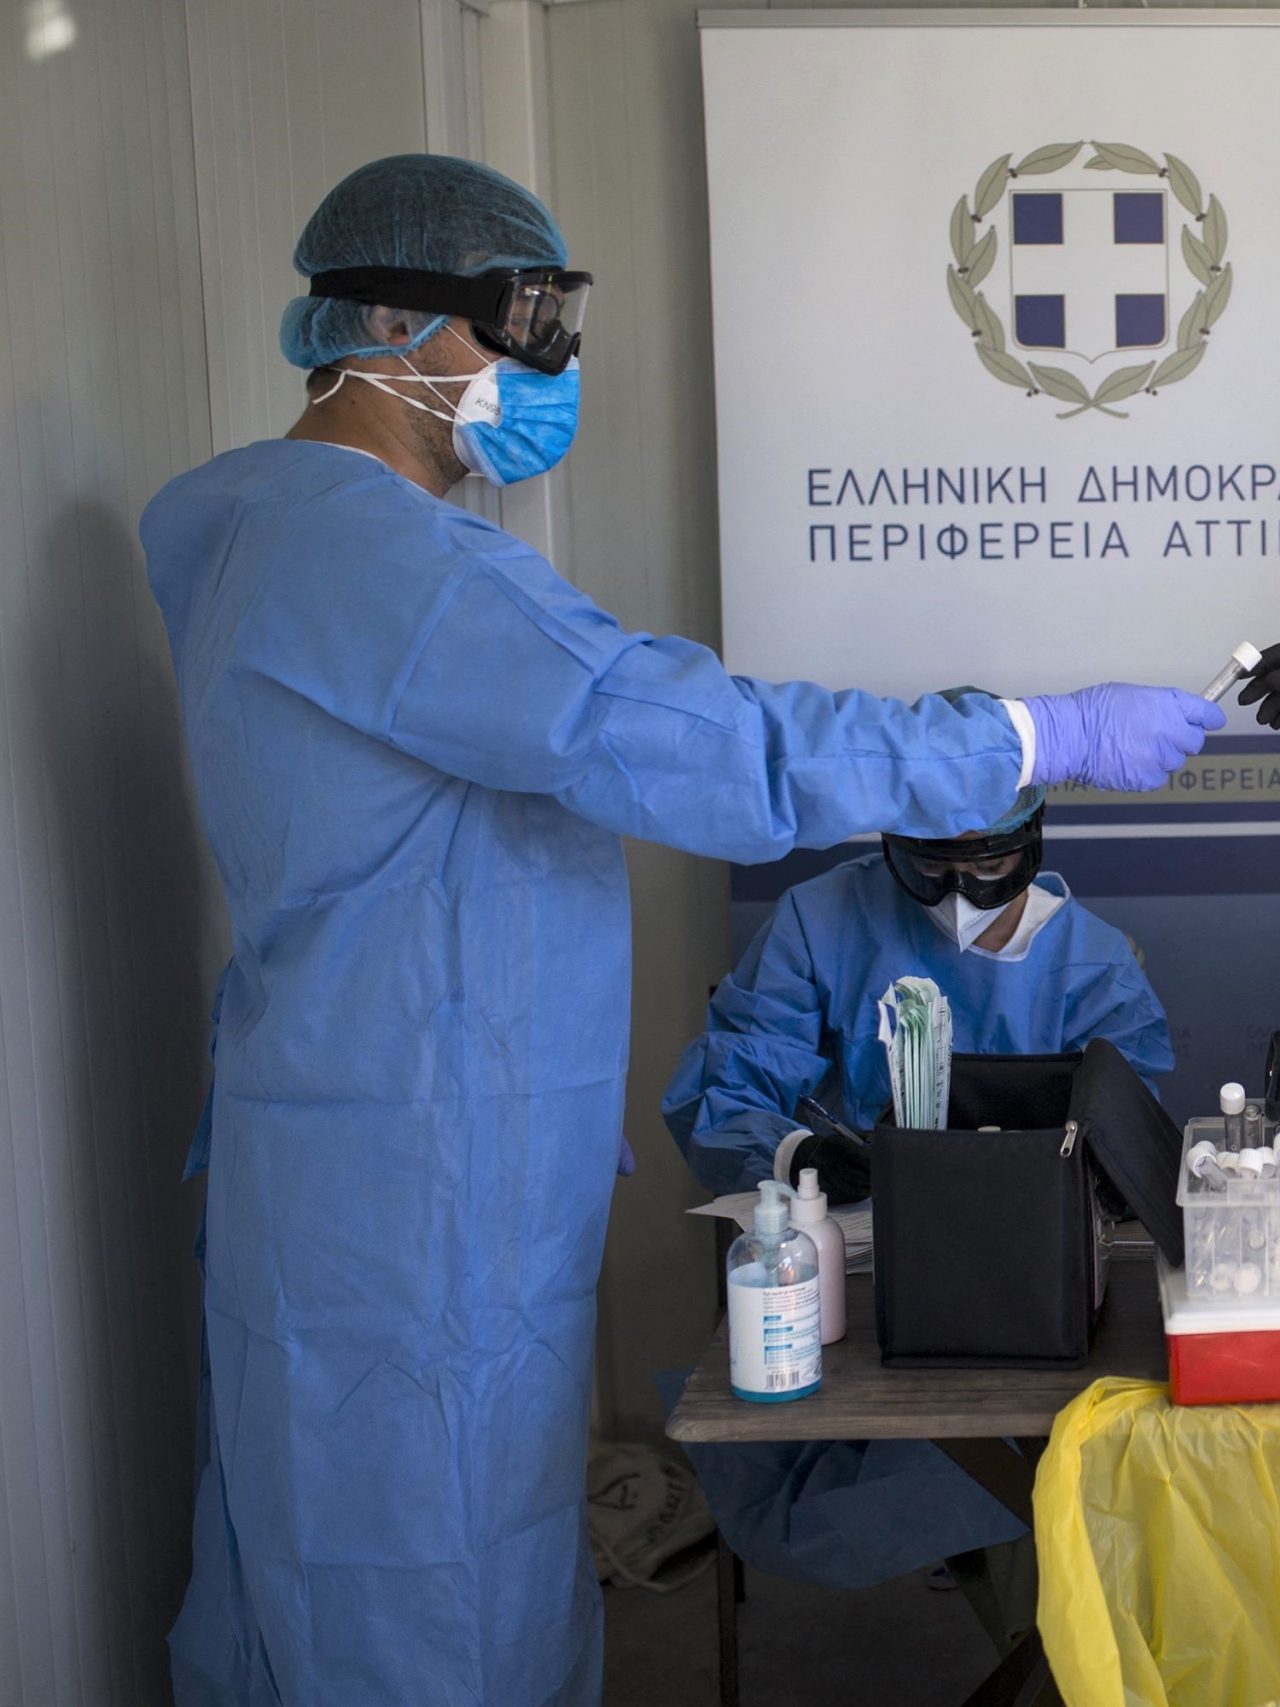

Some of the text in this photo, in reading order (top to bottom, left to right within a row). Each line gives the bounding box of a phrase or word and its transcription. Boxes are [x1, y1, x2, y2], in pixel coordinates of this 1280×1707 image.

[474, 397, 502, 417] KN95
[807, 465, 1047, 507] ΕΛΛΗΝΙΚΗ
[808, 520, 1130, 563] ΠΕΡΙΦΕΡΕΙΑ
